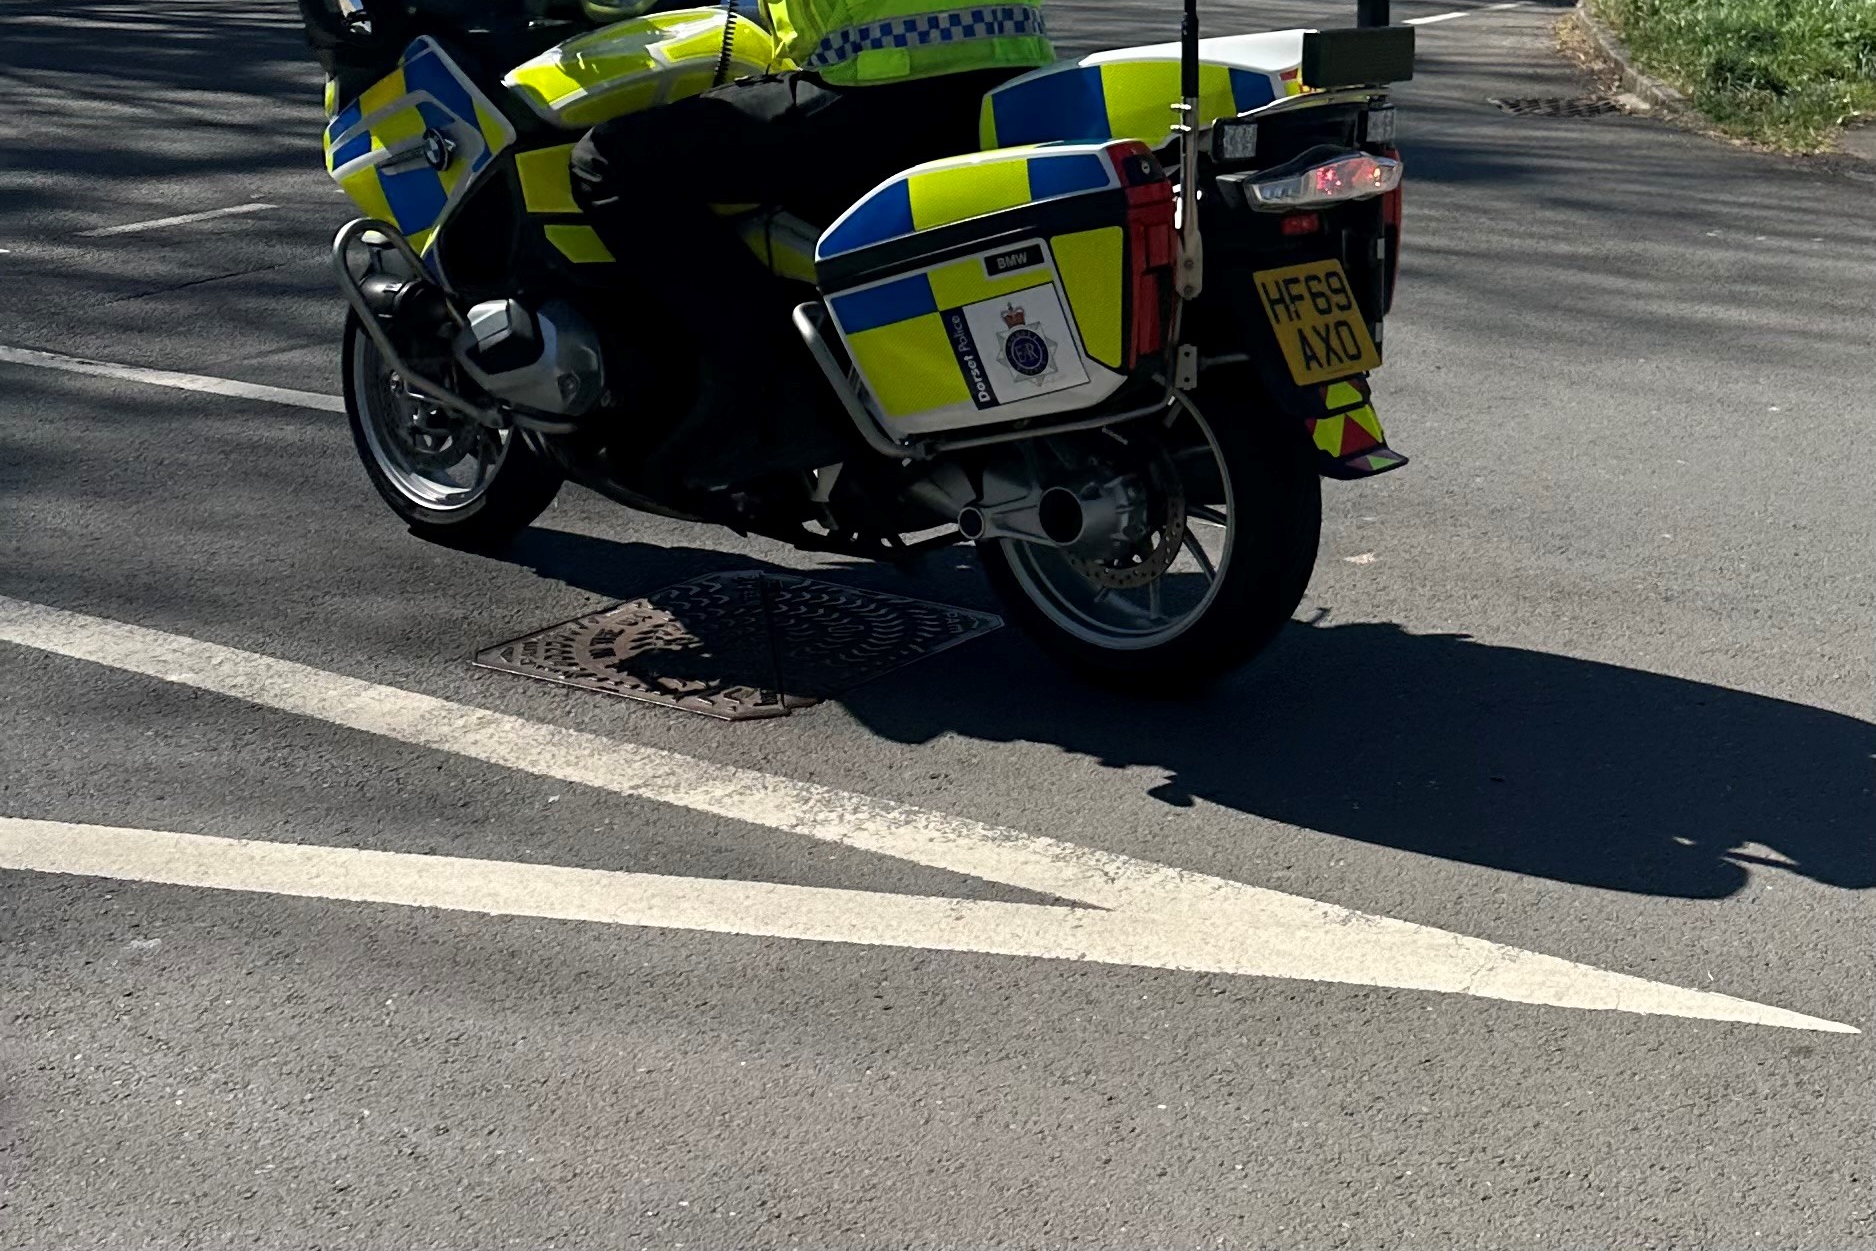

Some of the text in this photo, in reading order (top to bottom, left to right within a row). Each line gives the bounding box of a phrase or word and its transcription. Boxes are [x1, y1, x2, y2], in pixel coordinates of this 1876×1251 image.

[996, 252, 1028, 270] BMW
[1261, 270, 1353, 325] HF69
[952, 315, 991, 403] Dorset Police
[1297, 319, 1363, 372] AXO
